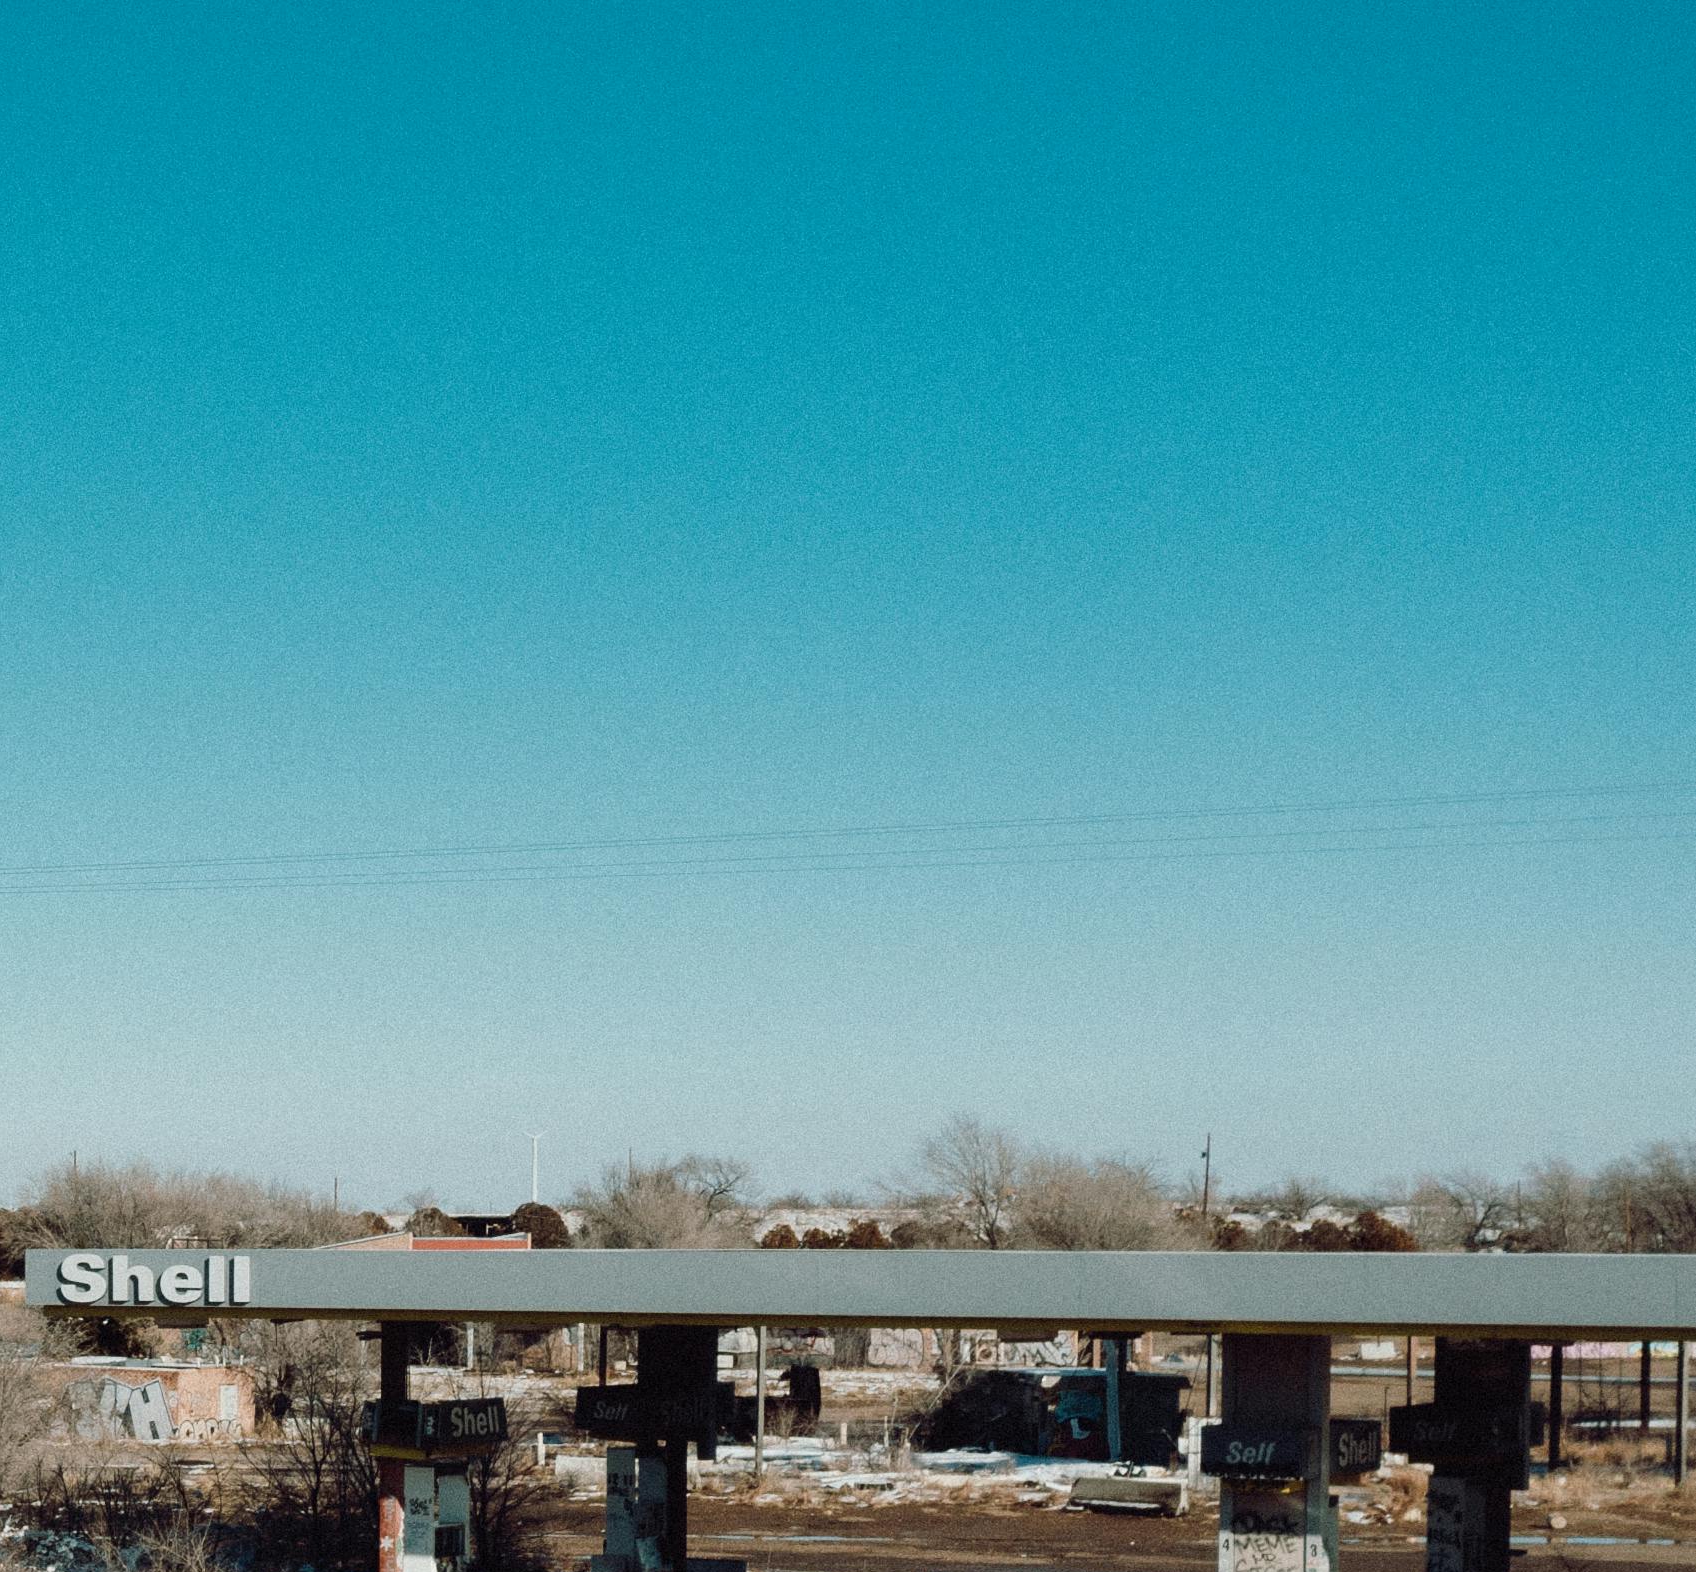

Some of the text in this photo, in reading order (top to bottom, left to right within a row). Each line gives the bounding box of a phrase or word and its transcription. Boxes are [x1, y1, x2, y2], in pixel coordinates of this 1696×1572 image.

[57, 1253, 251, 1306] Shell
[450, 1405, 500, 1438] Shell
[1225, 1441, 1276, 1464] Self
[1338, 1431, 1378, 1467] Shell
